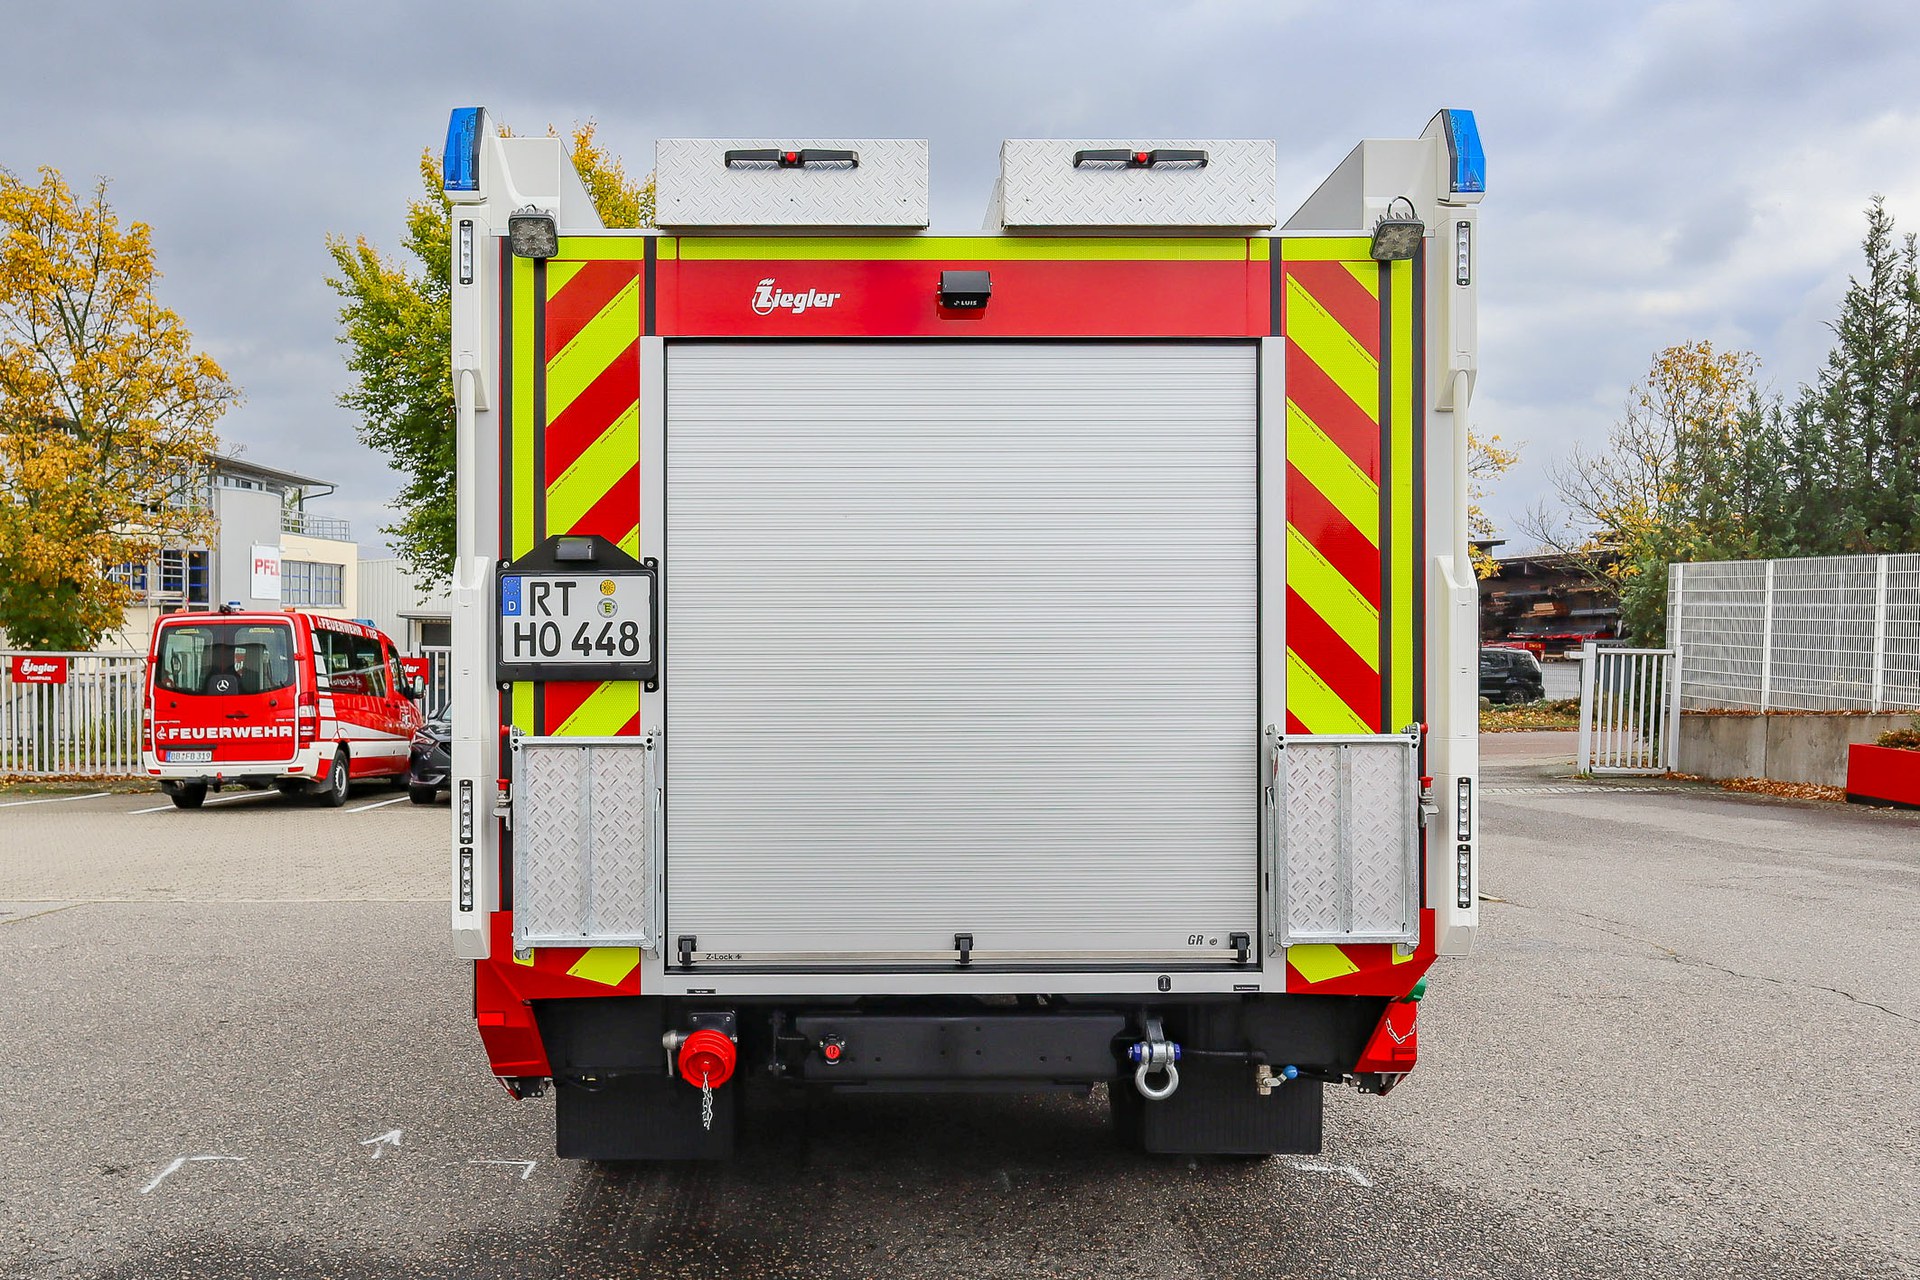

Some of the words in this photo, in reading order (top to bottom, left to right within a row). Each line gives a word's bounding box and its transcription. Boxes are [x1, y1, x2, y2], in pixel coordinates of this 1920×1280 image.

[752, 278, 841, 316] Ziegler
[508, 601, 517, 611] D
[529, 581, 577, 616] RT
[322, 618, 363, 637] FEUERWEHR
[513, 621, 562, 657] HO
[571, 621, 640, 657] 448
[20, 658, 59, 675] Ziegler
[168, 725, 293, 740] FEUERWEHR
[196, 751, 211, 760] 319
[1187, 934, 1204, 946] GR
